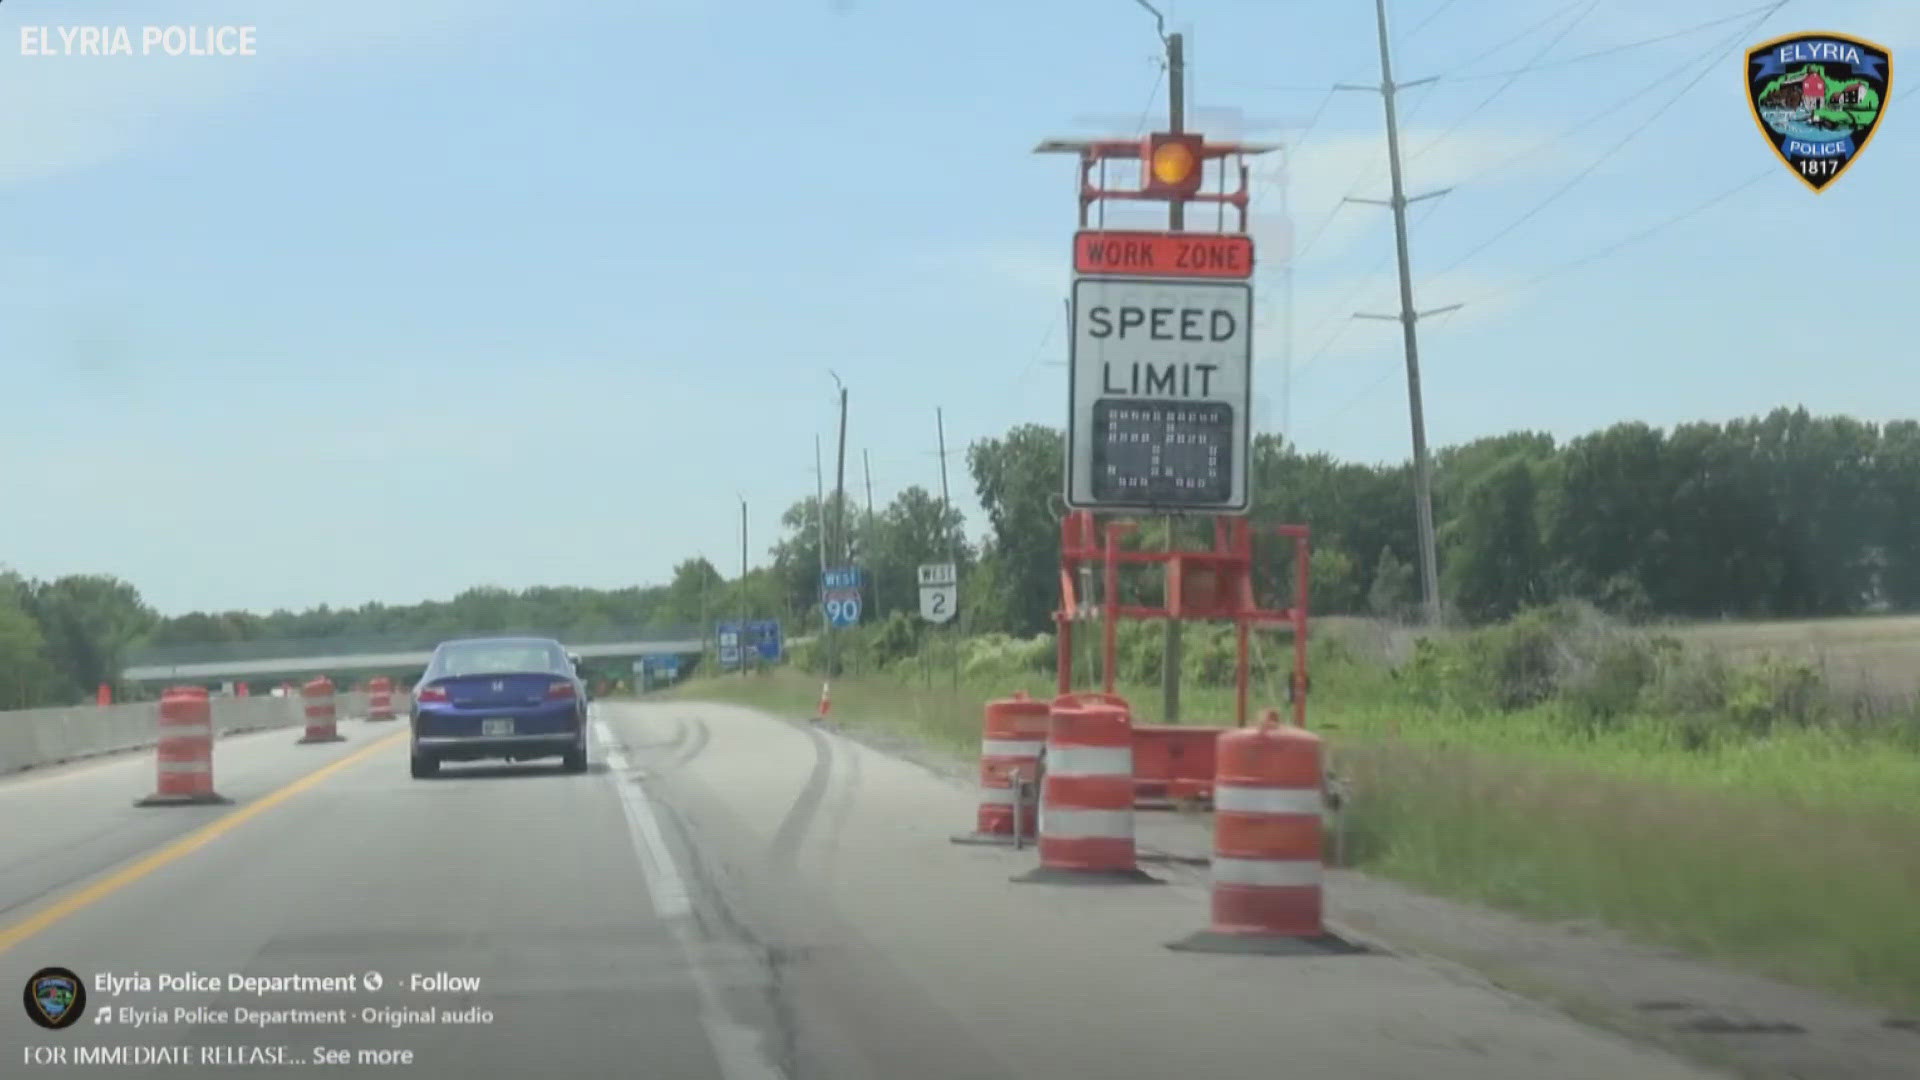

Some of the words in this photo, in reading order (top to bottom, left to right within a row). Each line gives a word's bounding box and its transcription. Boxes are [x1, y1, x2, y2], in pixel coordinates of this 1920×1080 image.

[1088, 242, 1155, 266] WORK
[1175, 241, 1241, 270] ZONE
[1089, 307, 1236, 342] SPEED
[1103, 362, 1218, 397] LIMIT
[1107, 409, 1218, 488] 55
[825, 572, 855, 586] WEST
[922, 568, 954, 581] WEST
[827, 601, 857, 622] 90
[932, 593, 945, 614] 2
